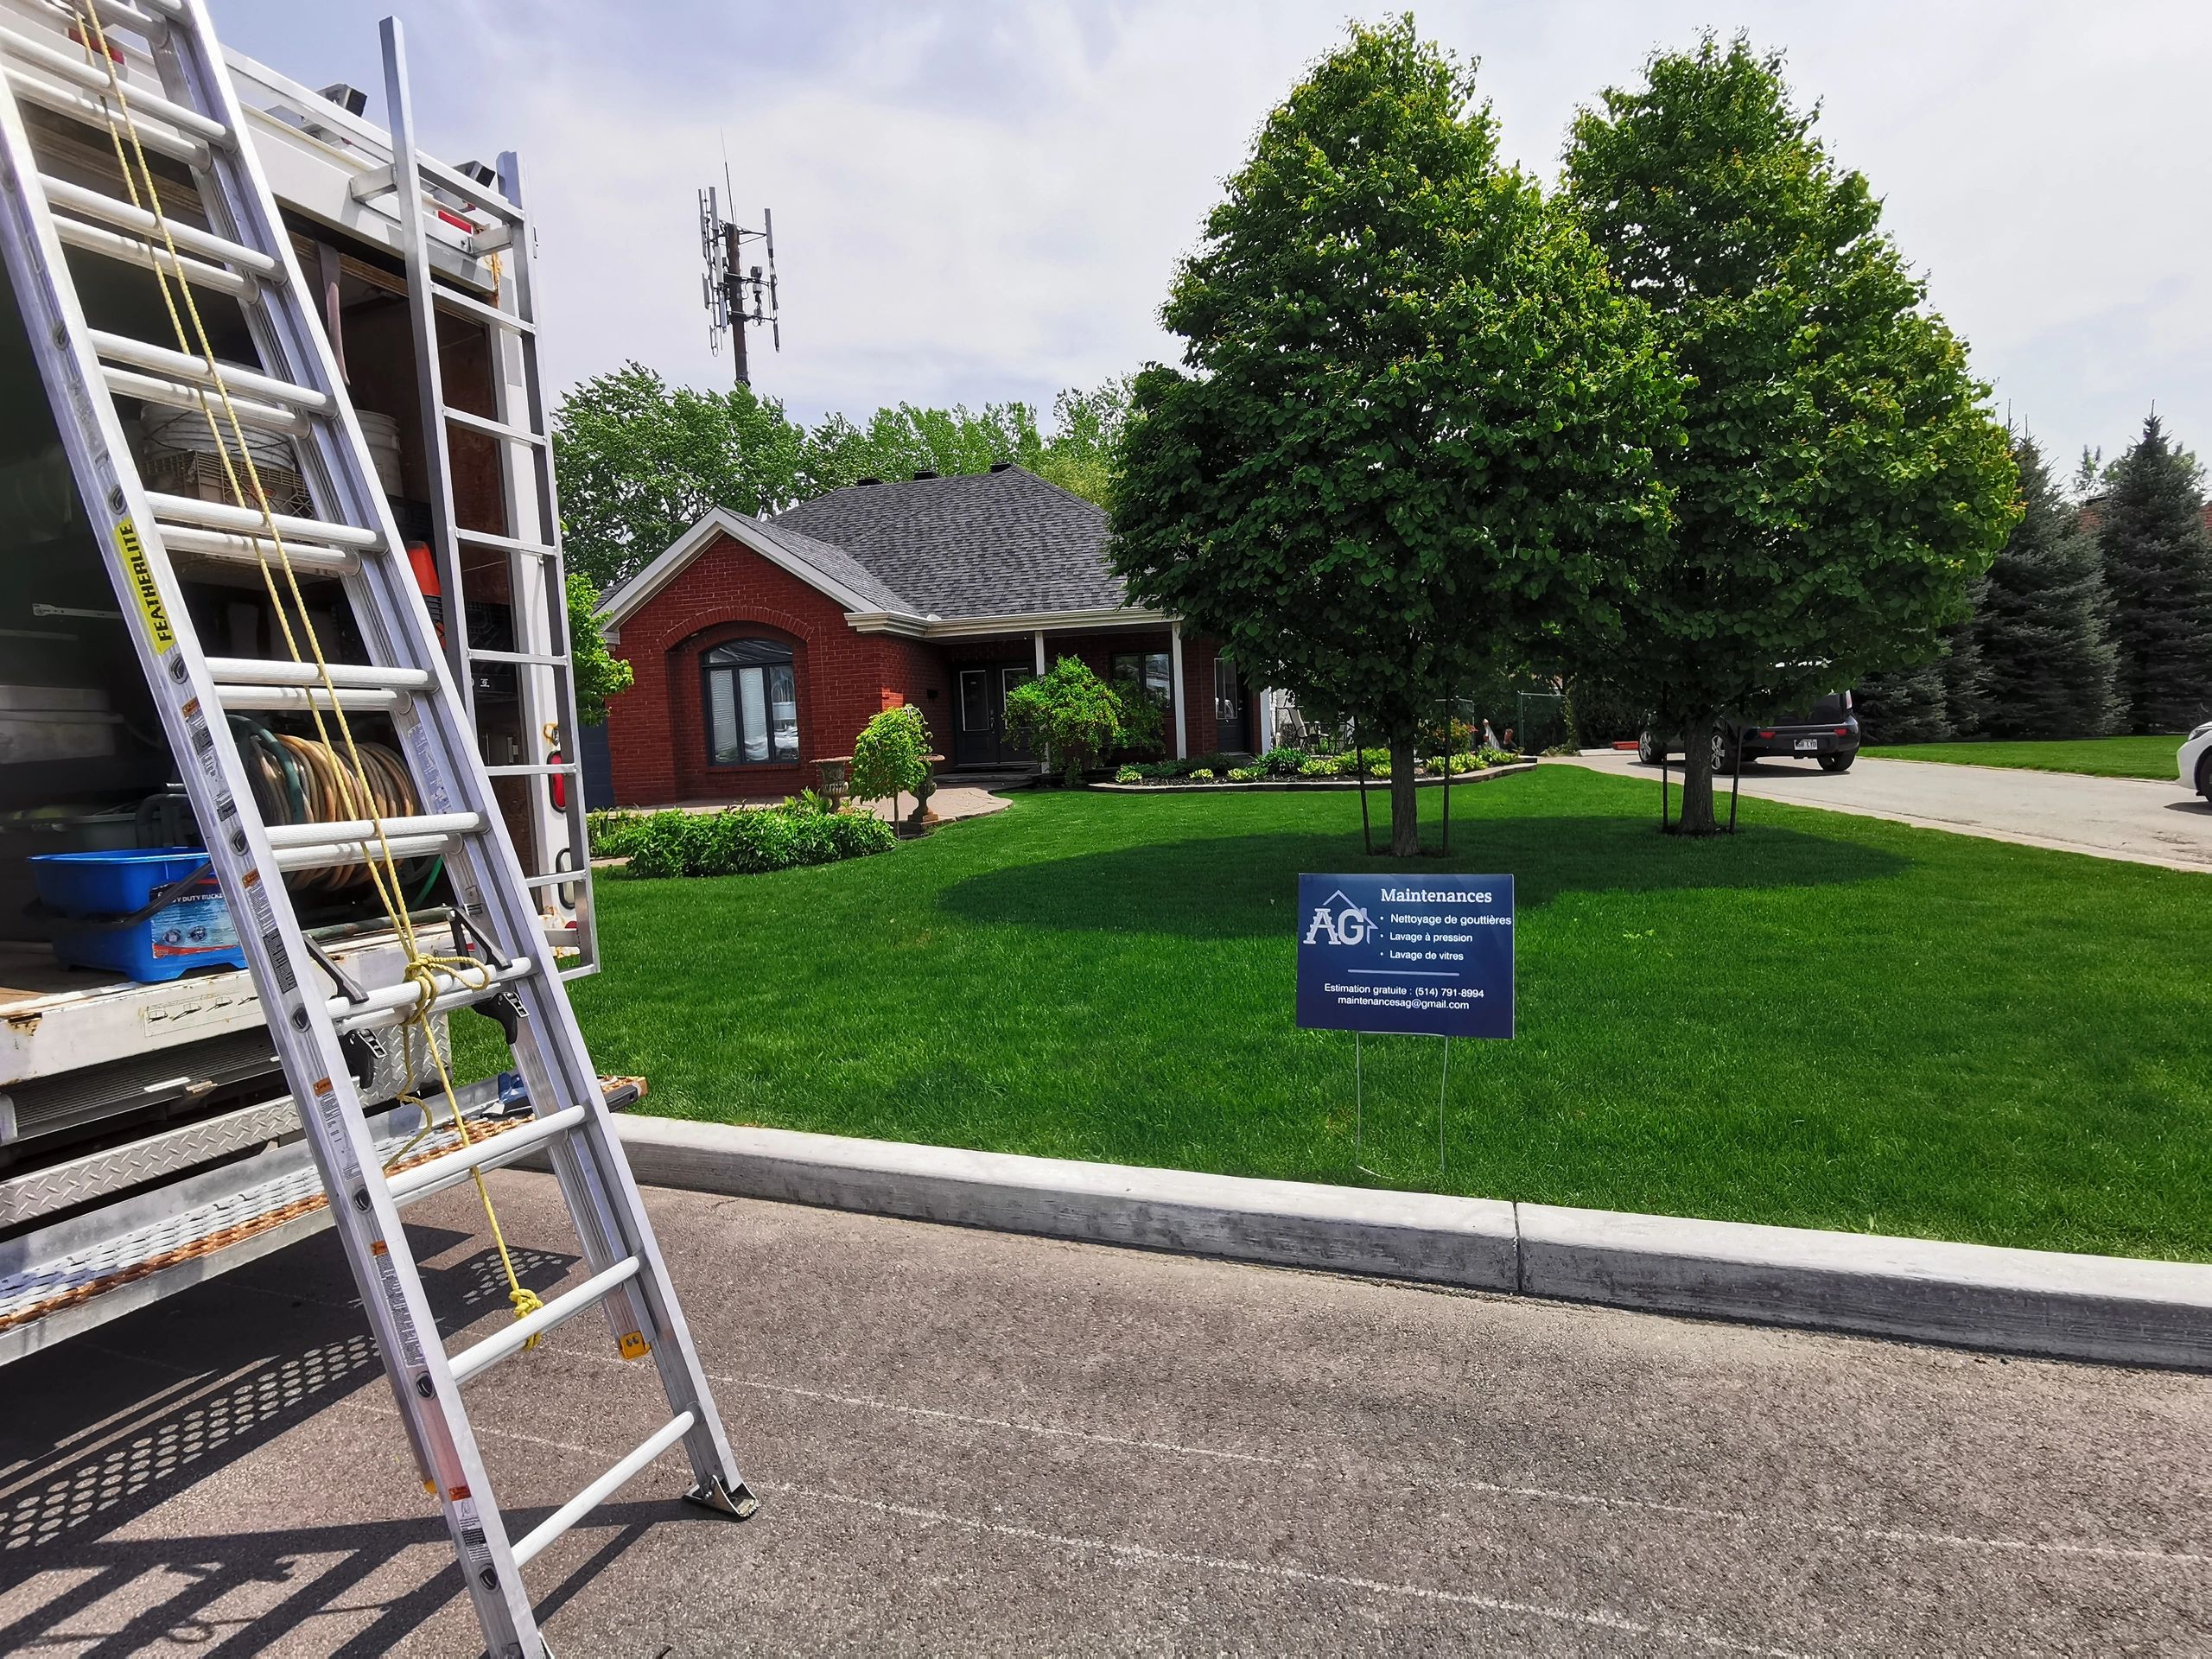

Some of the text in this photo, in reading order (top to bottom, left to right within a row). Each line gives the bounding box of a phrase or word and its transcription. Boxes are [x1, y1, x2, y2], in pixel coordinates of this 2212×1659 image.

[120, 524, 173, 642] FEATHERLITE
[1381, 888, 1492, 903] Maintenances
[1303, 908, 1363, 945] AG
[1390, 913, 1512, 926] Nettoyage de gouttières
[1389, 932, 1473, 943] Lavage à pression
[1389, 950, 1464, 961] Lavage de vitres
[1325, 982, 1370, 994] Estimation
[1373, 987, 1407, 995] gratuite
[1414, 988, 1439, 997] (514)
[1441, 988, 1484, 998] 791-8994
[1338, 996, 1470, 1009] maintenancesag@gmail.com
